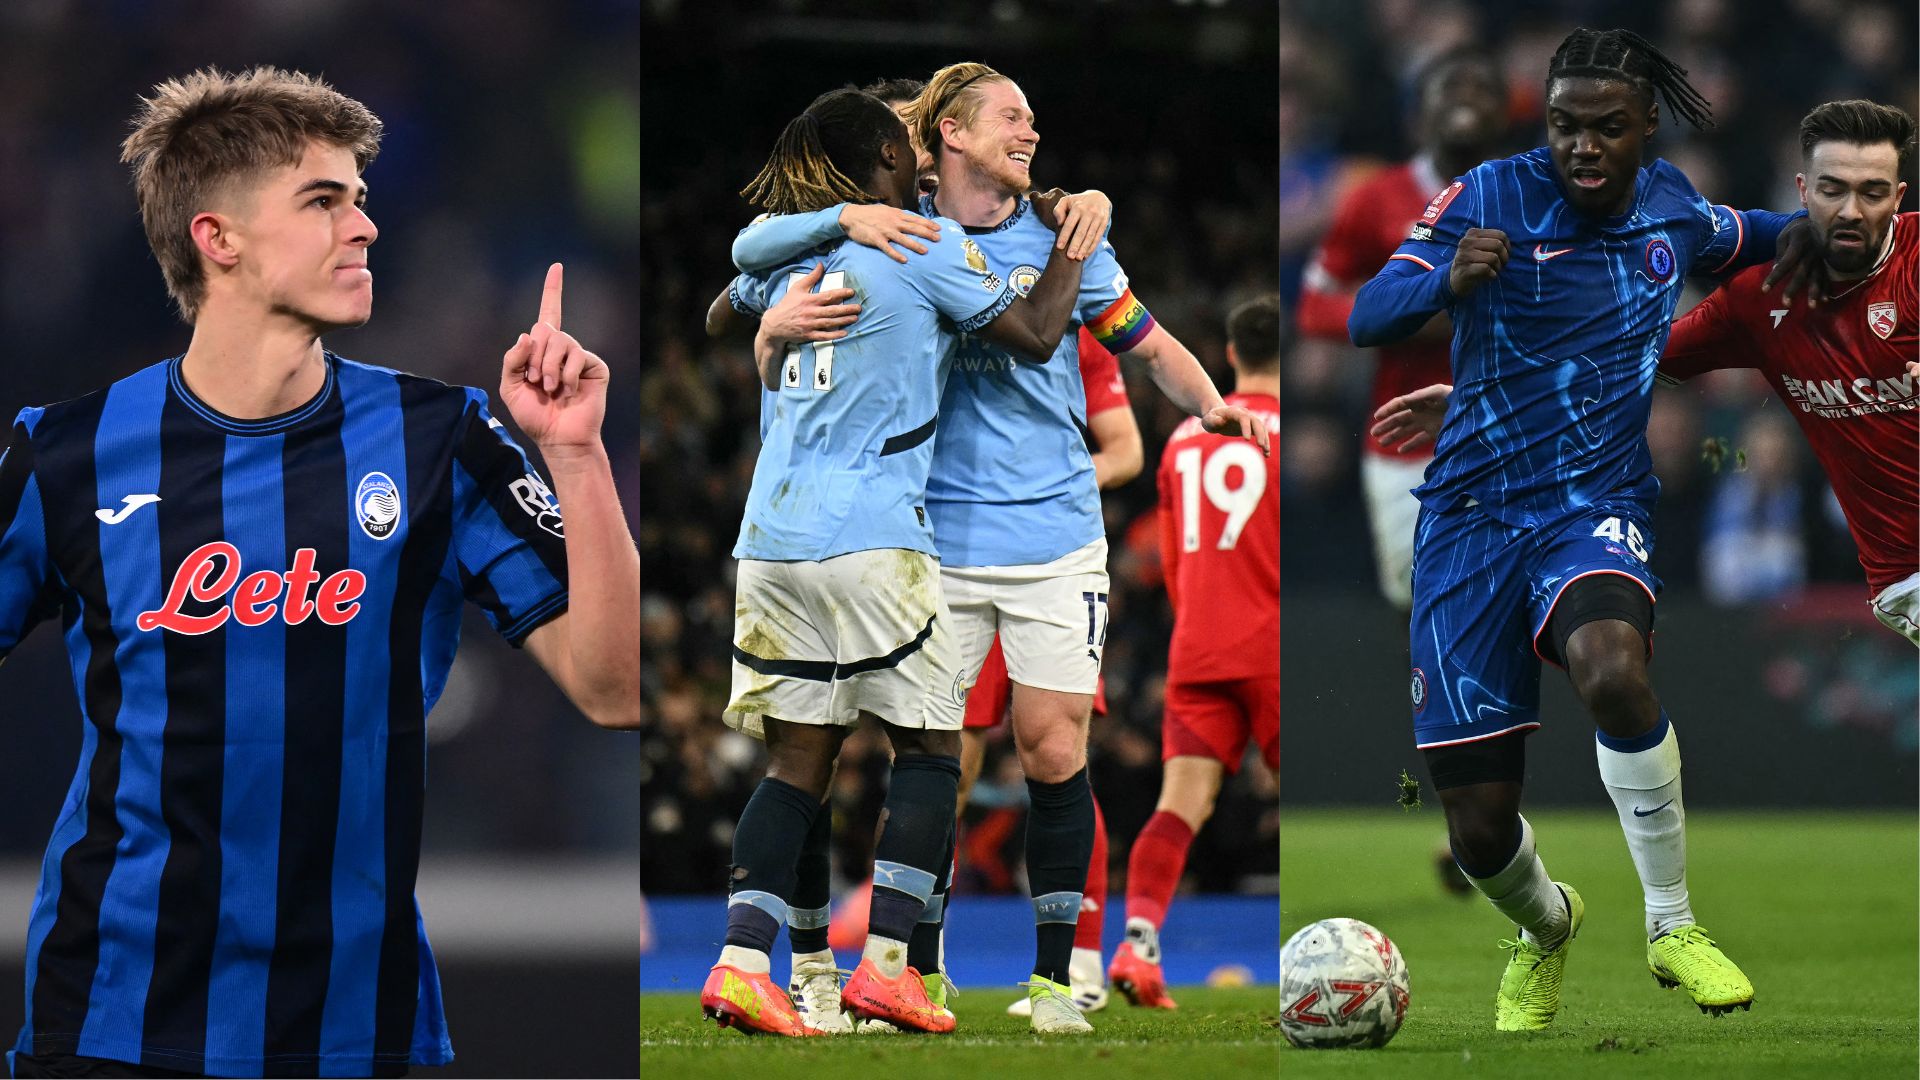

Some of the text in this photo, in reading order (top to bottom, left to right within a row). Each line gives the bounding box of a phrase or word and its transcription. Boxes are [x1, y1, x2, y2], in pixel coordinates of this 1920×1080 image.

[1852, 373, 1918, 402] CAV
[1174, 440, 1267, 553] 19
[369, 524, 388, 532] 1907
[136, 541, 367, 636] Lete
